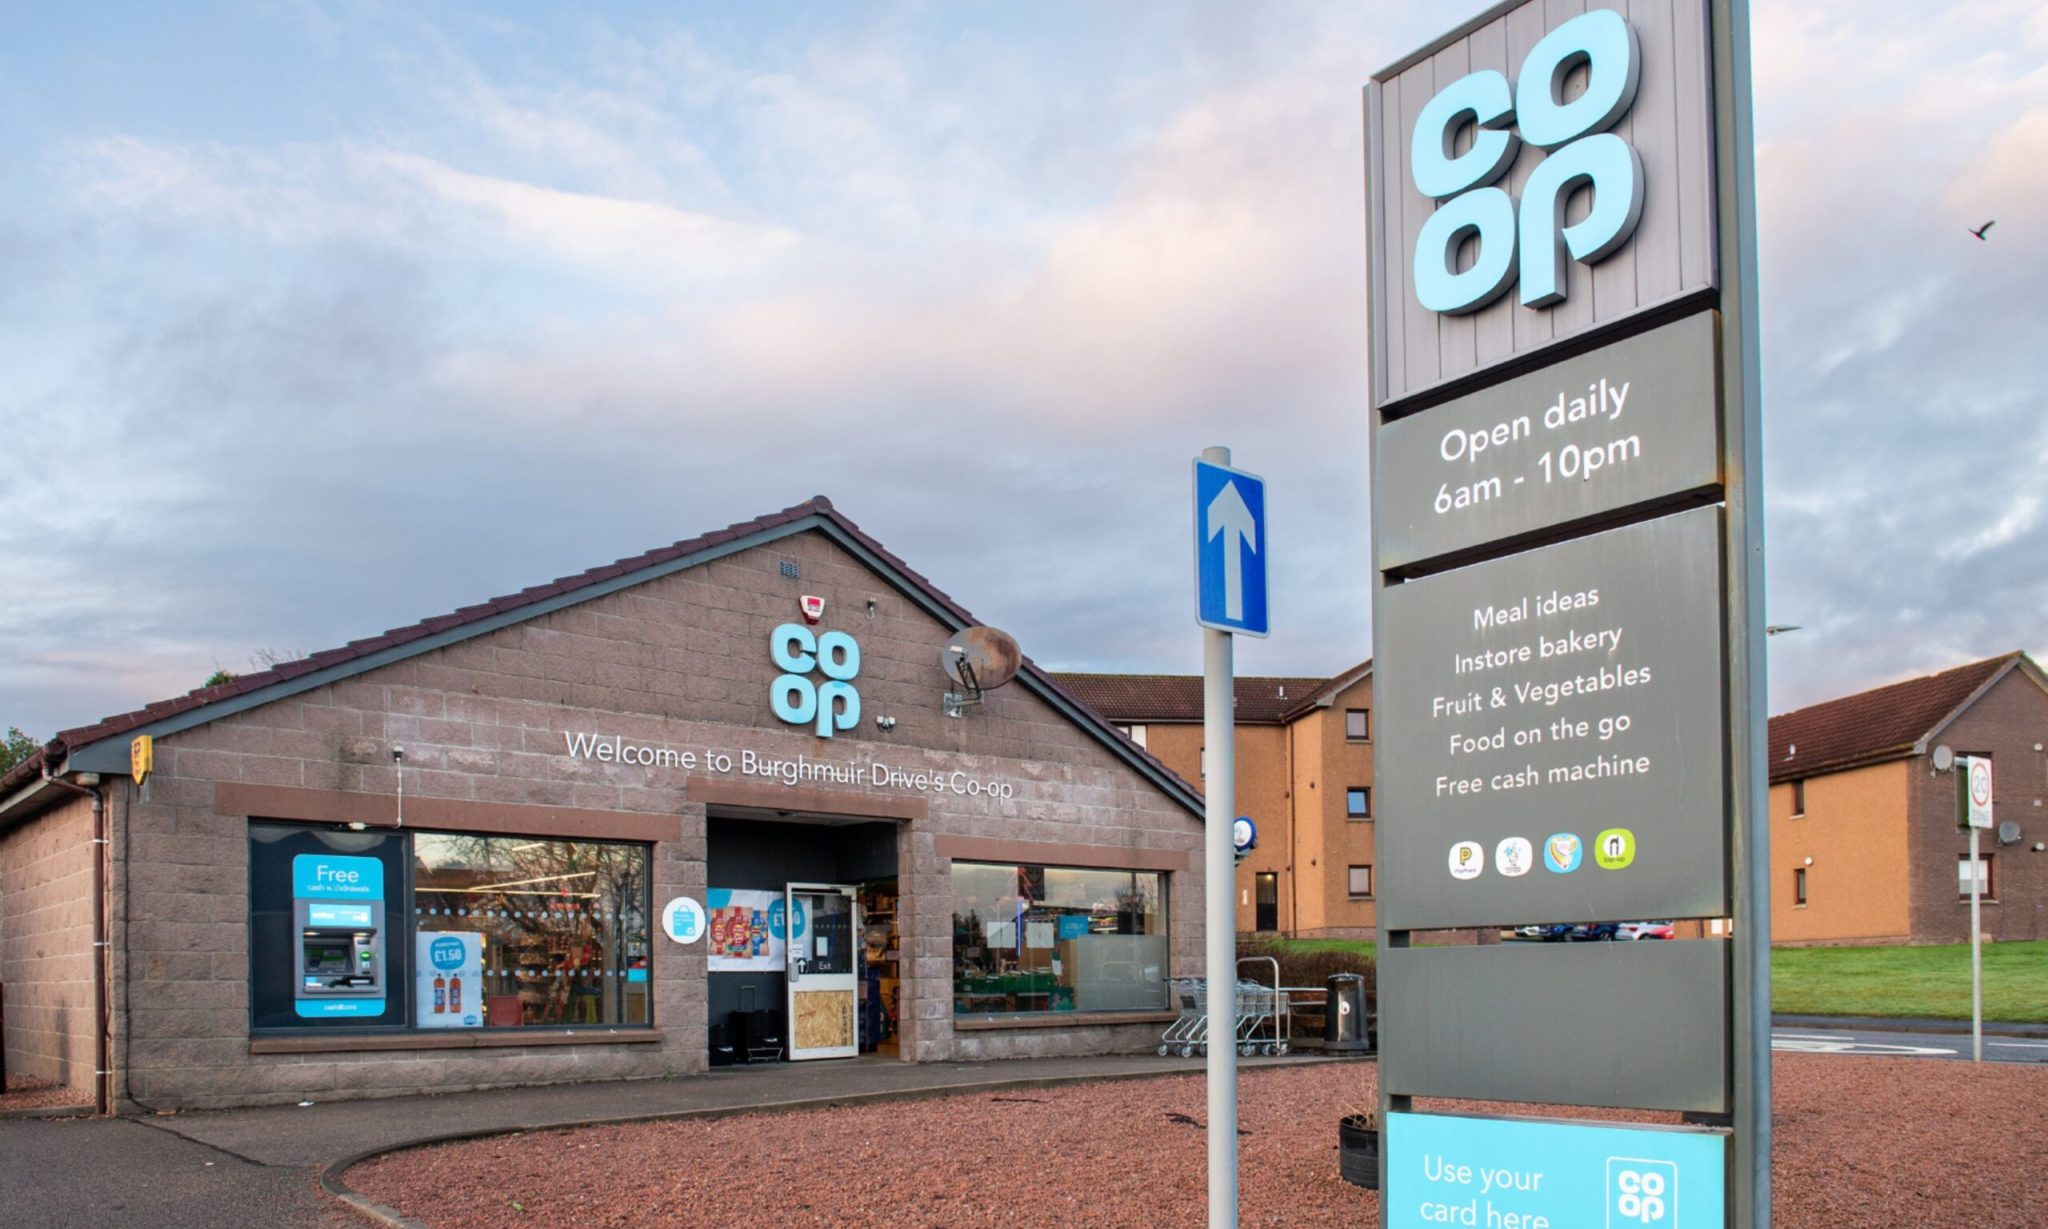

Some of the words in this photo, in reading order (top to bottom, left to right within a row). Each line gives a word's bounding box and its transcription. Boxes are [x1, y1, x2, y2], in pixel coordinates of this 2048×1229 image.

[1439, 415, 1531, 464] Open
[1543, 377, 1631, 430] daily
[1433, 476, 1502, 515] 6am
[1537, 434, 1641, 484] 10pm
[1473, 597, 1528, 631] Meal
[1535, 588, 1600, 618] ideas
[1455, 645, 1532, 675] Instore
[1539, 627, 1623, 658] bakery
[1432, 691, 1483, 718] Fruit
[1489, 687, 1507, 709] &
[1513, 663, 1652, 706] Vegetables
[1450, 726, 1505, 756] Food
[1513, 728, 1542, 746] on
[1550, 716, 1589, 741] the
[1598, 714, 1631, 740] go
[565, 731, 697, 769] Welcome
[705, 749, 732, 773] to
[742, 749, 865, 785] Burghmuir
[872, 763, 944, 791] Drive's
[951, 771, 1014, 806] Co-op
[1436, 775, 1483, 797] Free
[1491, 764, 1539, 790] cash
[1548, 753, 1651, 784] machine
[317, 864, 359, 883] Free
[434, 948, 462, 963] £1.50
[818, 961, 832, 970] Exit
[1424, 1154, 1473, 1185] Use
[1480, 1168, 1544, 1194] your
[1420, 1200, 1477, 1227] card
[1486, 1201, 1550, 1229] here
